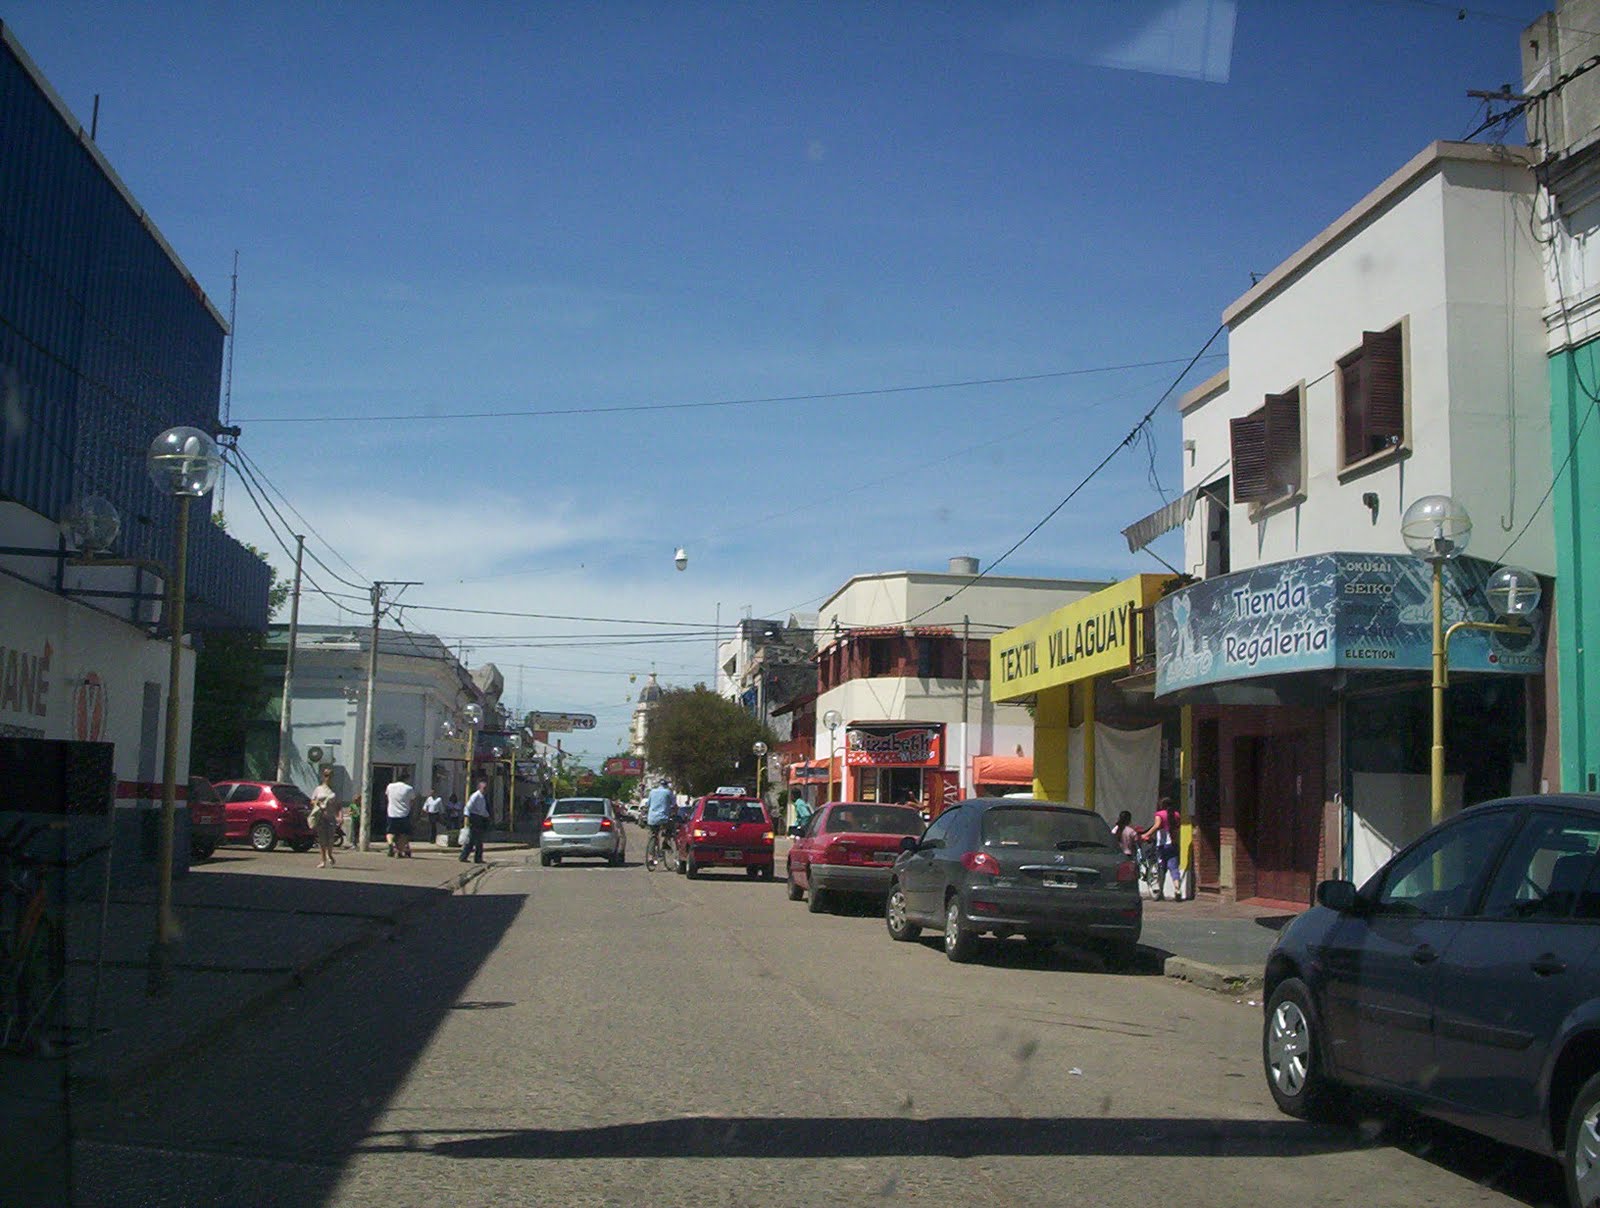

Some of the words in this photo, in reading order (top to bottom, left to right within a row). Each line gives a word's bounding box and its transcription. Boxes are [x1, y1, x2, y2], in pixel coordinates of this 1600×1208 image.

[1233, 580, 1306, 618] Tienda
[1344, 583, 1393, 594] SEIKO
[1000, 641, 1040, 683] TEXTIL
[1048, 605, 1128, 669] VILLAGUAY
[1225, 624, 1328, 666] Regalería
[1345, 649, 1396, 660] ELECTION
